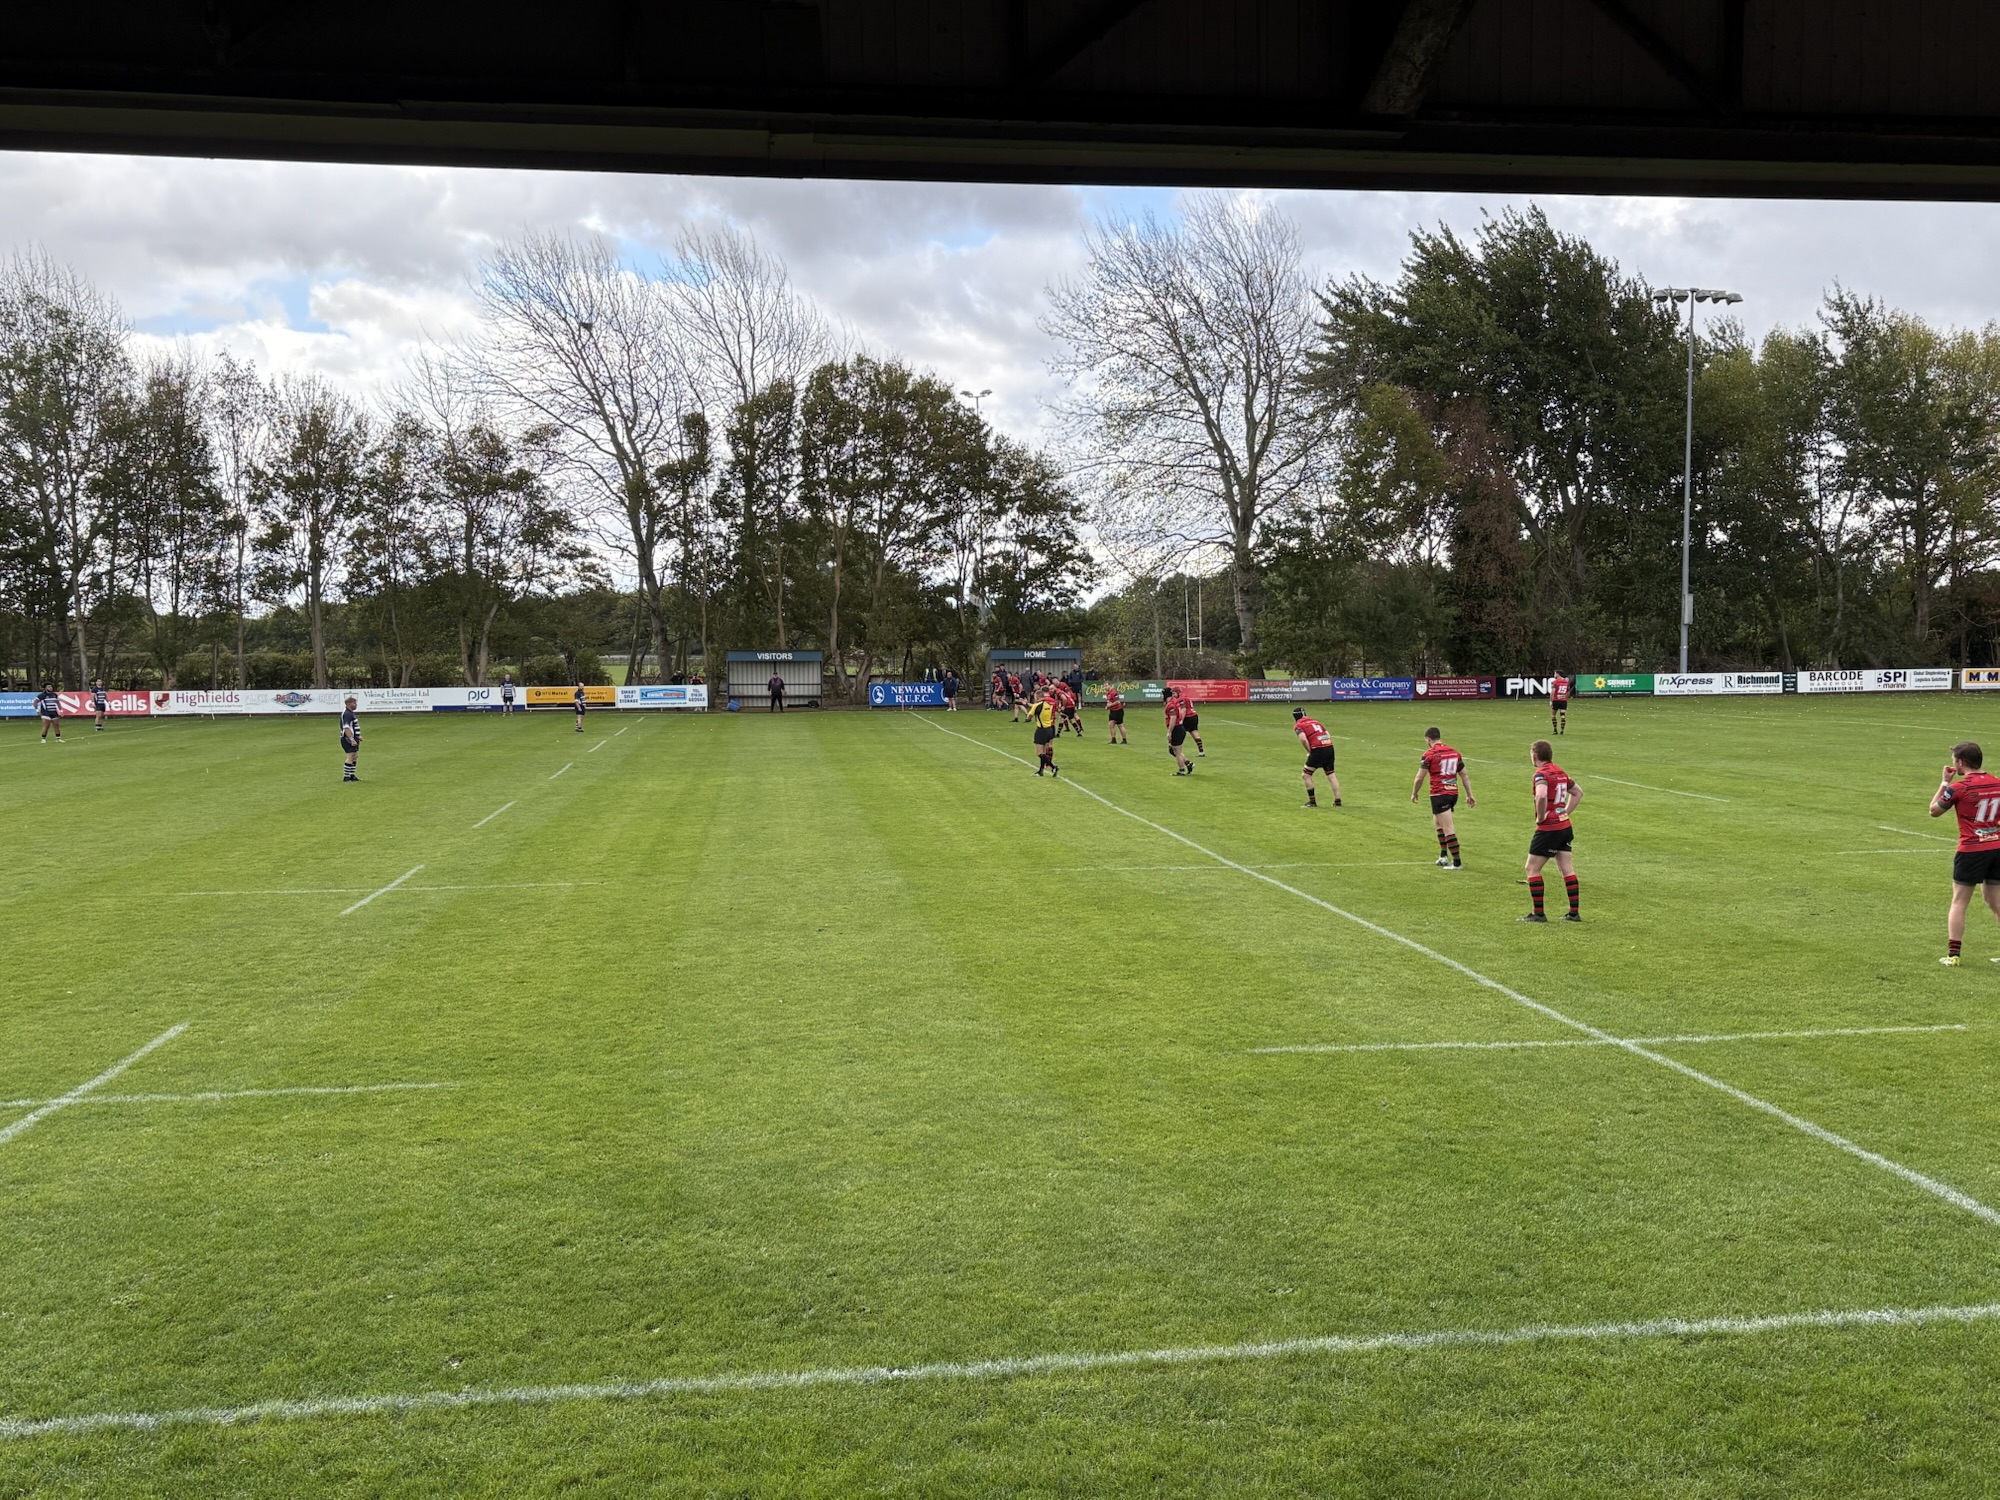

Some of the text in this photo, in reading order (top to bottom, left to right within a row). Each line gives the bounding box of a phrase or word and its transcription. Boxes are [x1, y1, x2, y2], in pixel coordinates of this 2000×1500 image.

[757, 652, 793, 660] VISITORS
[1023, 650, 1047, 658] HOME
[1658, 675, 1714, 689] InXpress
[1737, 674, 1780, 685] Richmond
[1809, 671, 1864, 682] BARCODE
[1883, 671, 1907, 683] SPI
[1968, 671, 1999, 682] MKM
[890, 685, 935, 694] NEWARK
[1333, 678, 1411, 690] Cooks & Company
[1882, 681, 1907, 689] marine
[176, 691, 240, 707] Highfields
[363, 689, 430, 699] Viking Electrical Ltd
[467, 688, 490, 701] pjd
[895, 694, 932, 703] R.U.F.C.
[1439, 757, 1459, 776] 10
[1974, 797, 2000, 823] 11
